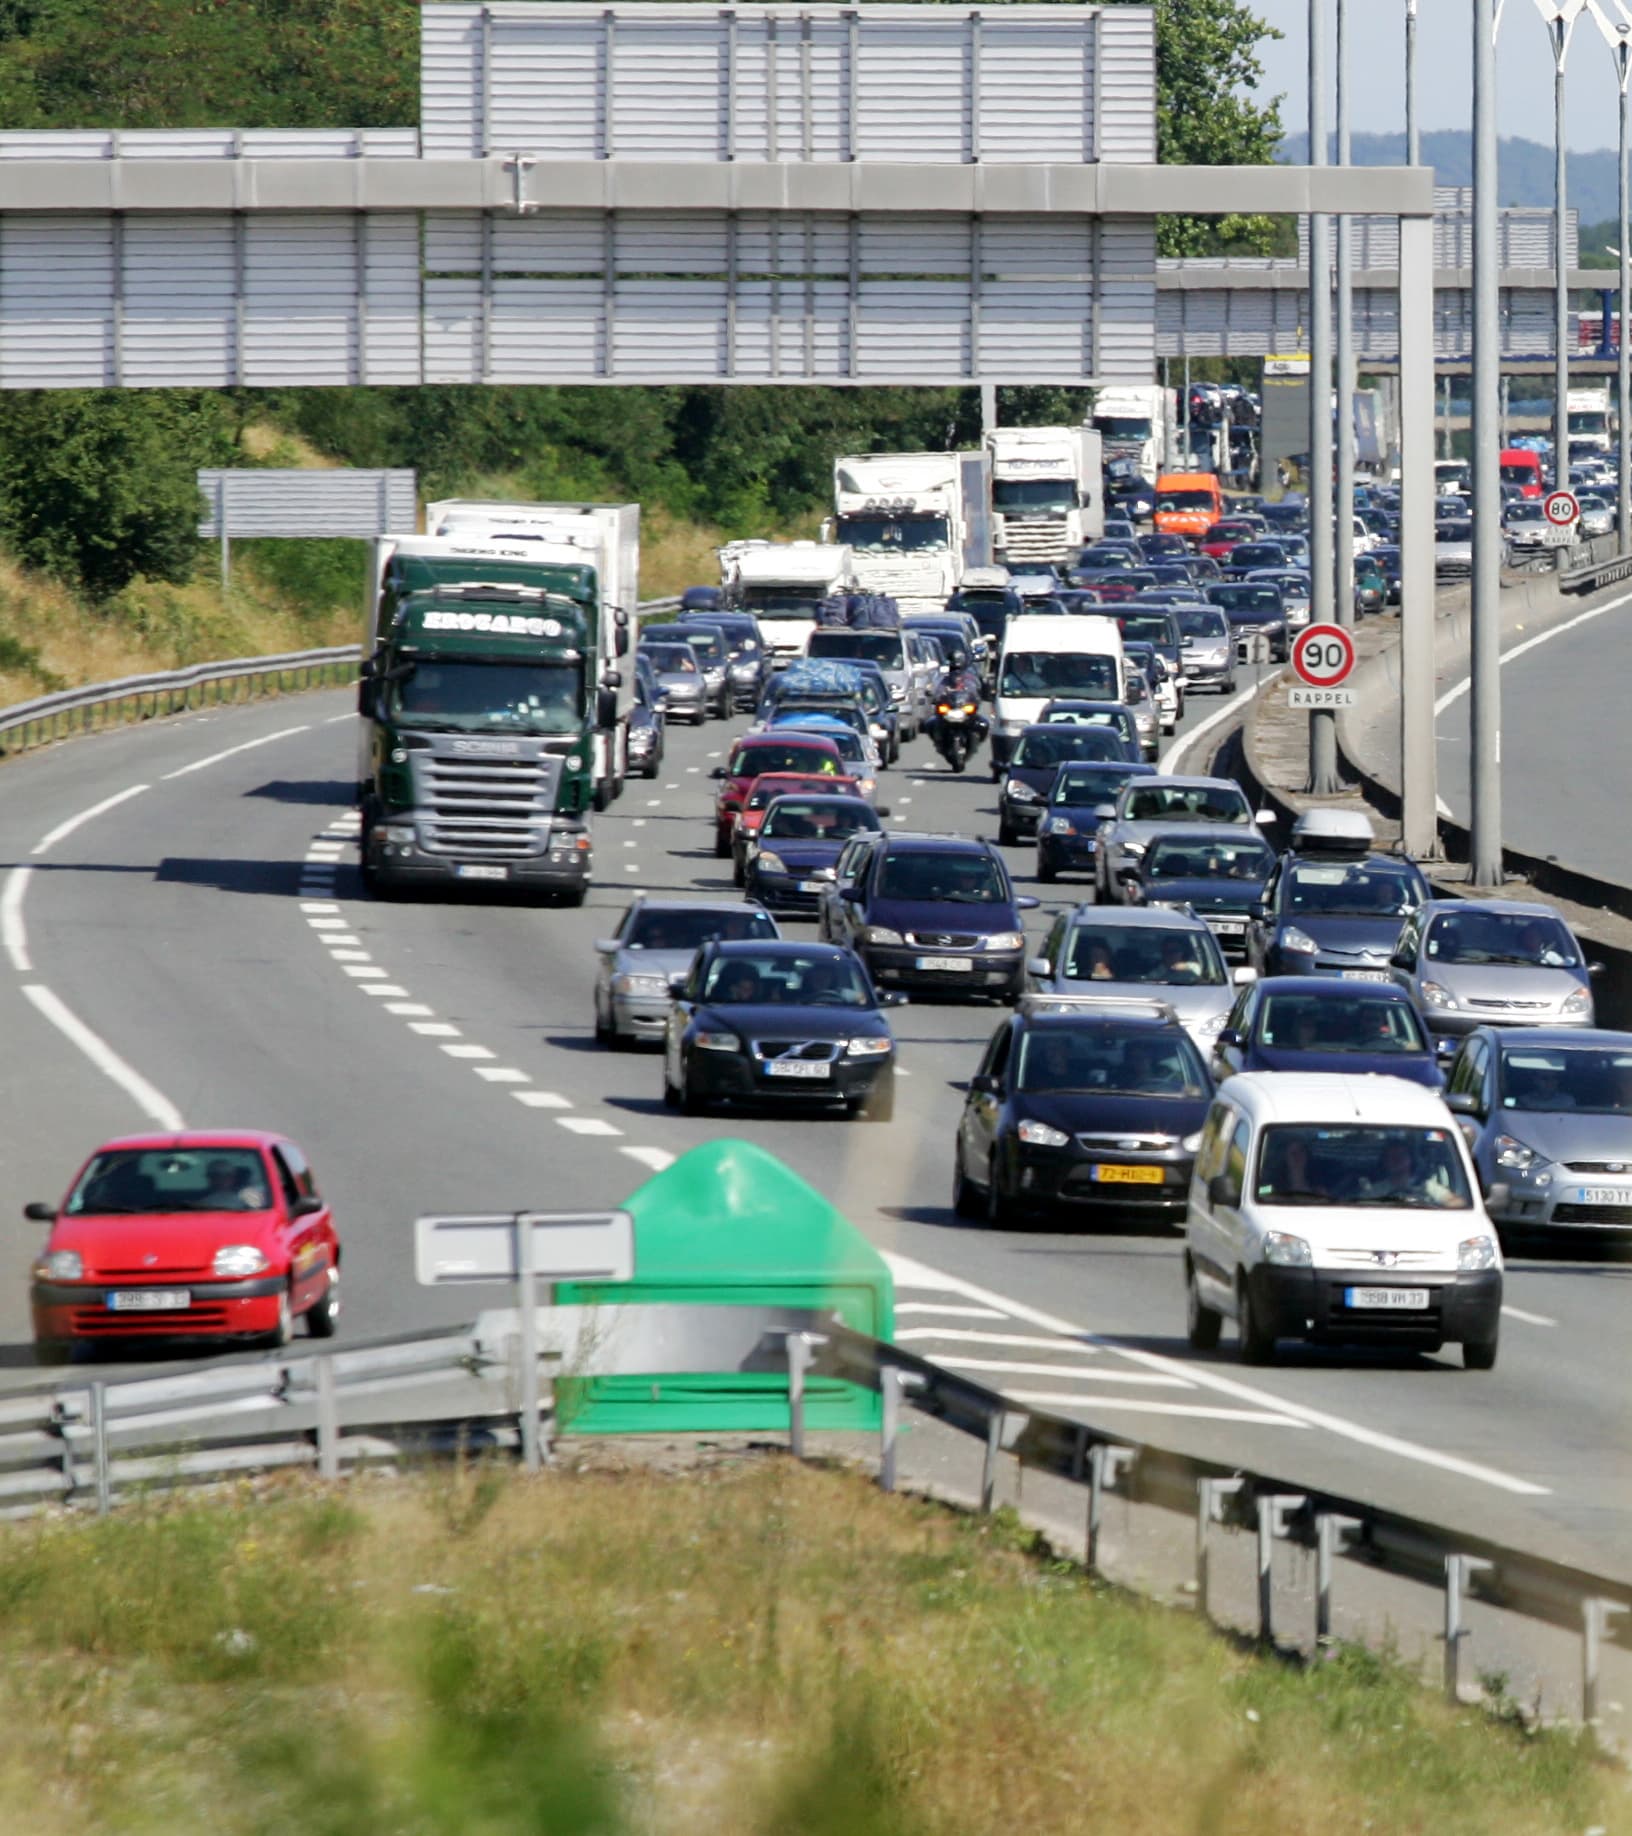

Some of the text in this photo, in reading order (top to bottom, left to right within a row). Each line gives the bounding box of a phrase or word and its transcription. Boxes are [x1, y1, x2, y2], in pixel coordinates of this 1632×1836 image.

[1551, 502, 1572, 516] 80
[1305, 642, 1343, 669] 90
[1293, 691, 1353, 705] RAPPEL
